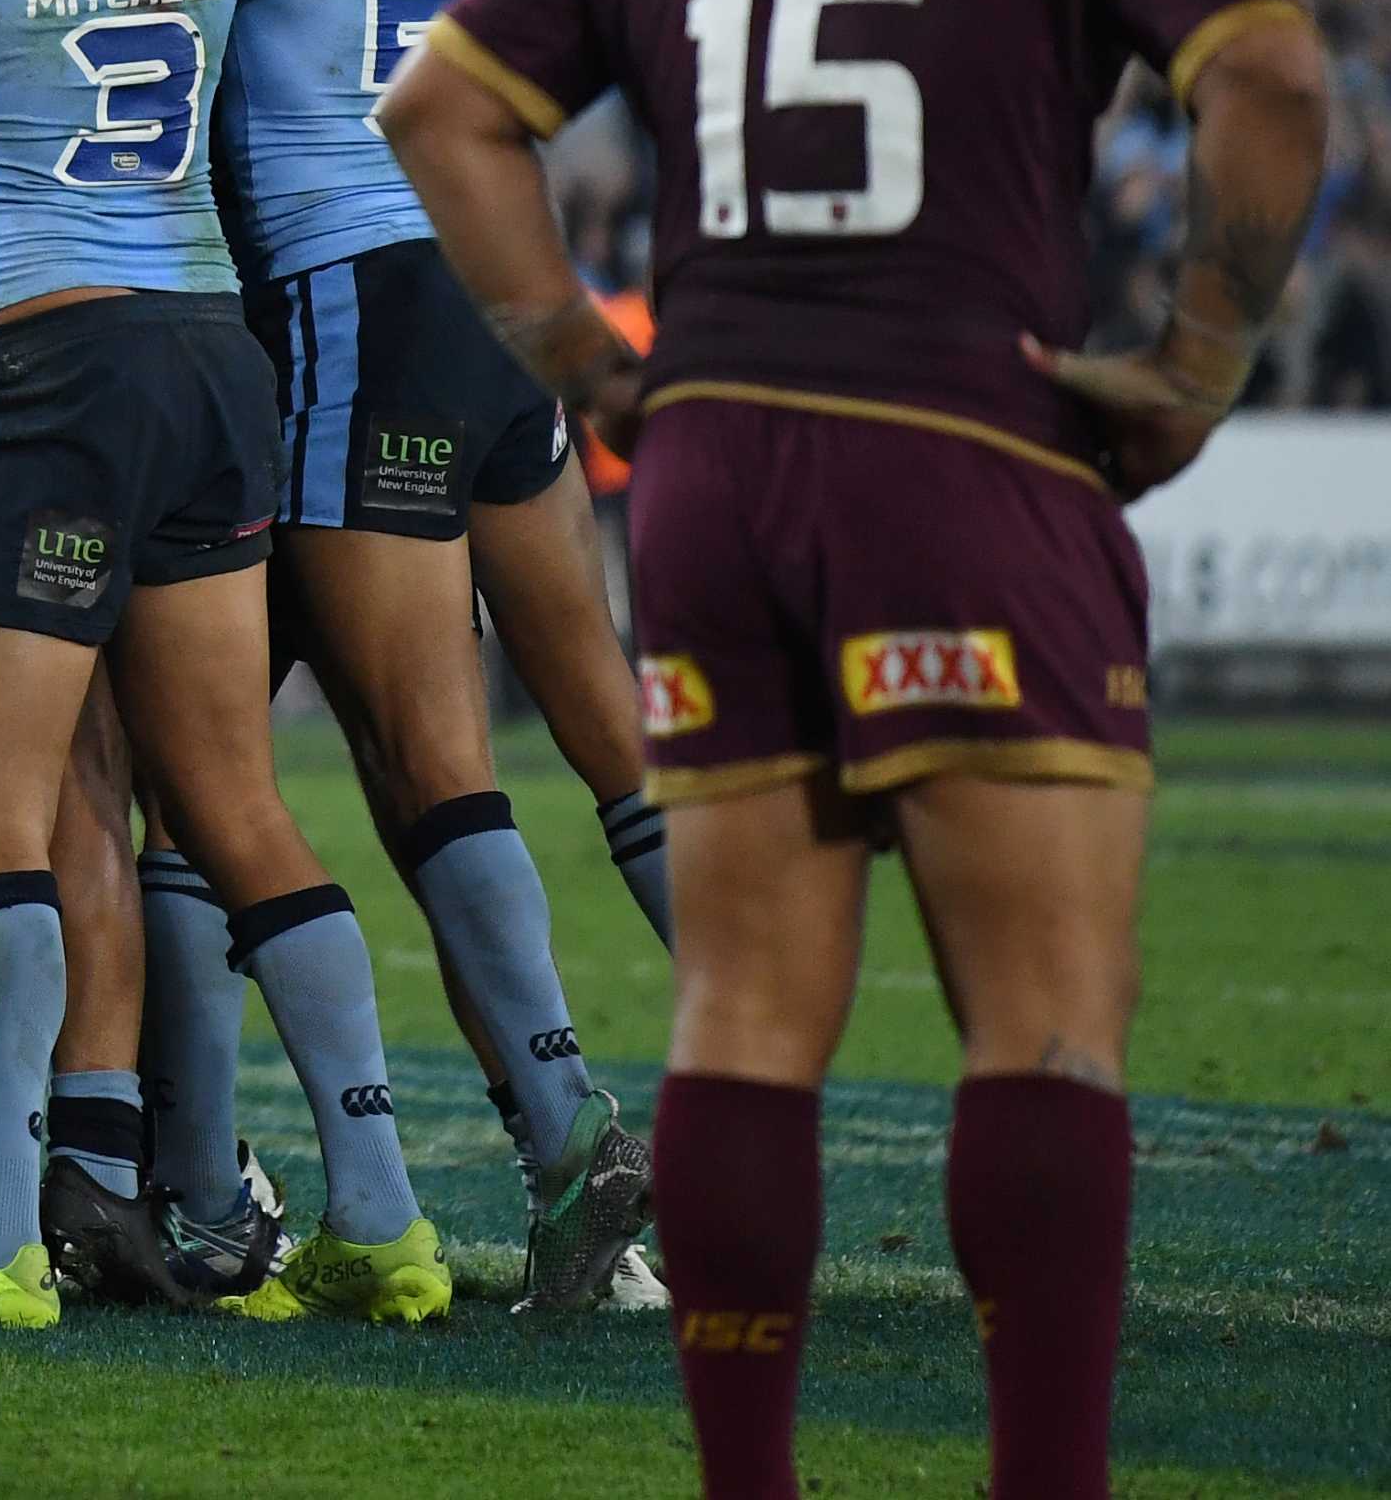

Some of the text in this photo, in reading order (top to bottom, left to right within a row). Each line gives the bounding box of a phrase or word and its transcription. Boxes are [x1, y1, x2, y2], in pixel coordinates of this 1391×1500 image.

[53, 11, 206, 186] 3
[379, 432, 452, 465] une
[378, 478, 447, 495] New England
[379, 465, 447, 483] University of
[37, 528, 105, 564] une
[33, 570, 97, 591] New England
[35, 558, 97, 580] University of
[862, 642, 1008, 700] XXXX
[321, 1254, 372, 1285] asics
